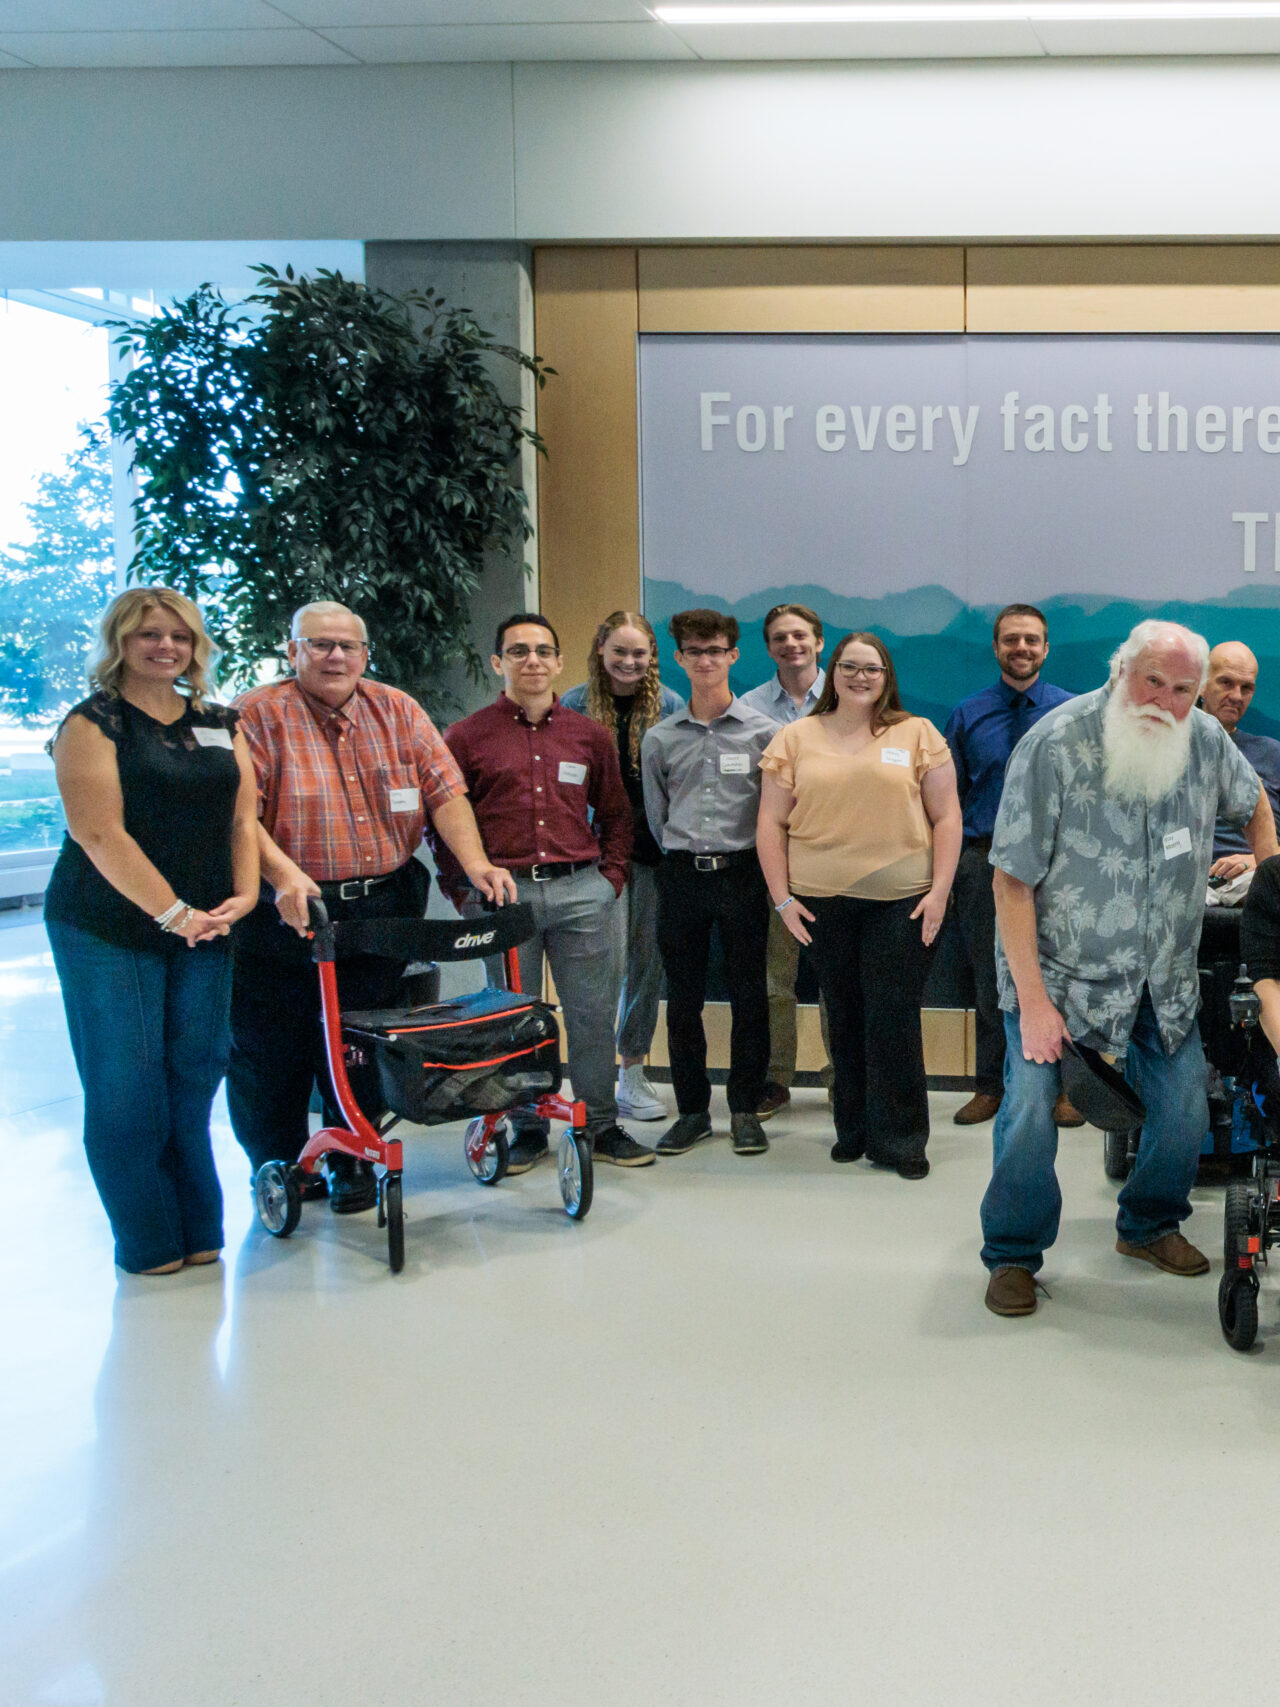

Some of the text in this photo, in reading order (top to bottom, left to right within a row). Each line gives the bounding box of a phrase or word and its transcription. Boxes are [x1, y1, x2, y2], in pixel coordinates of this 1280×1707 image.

[700, 391, 794, 452] For
[815, 403, 980, 466] every
[1000, 390, 1113, 452] fact
[453, 932, 494, 949] drive
